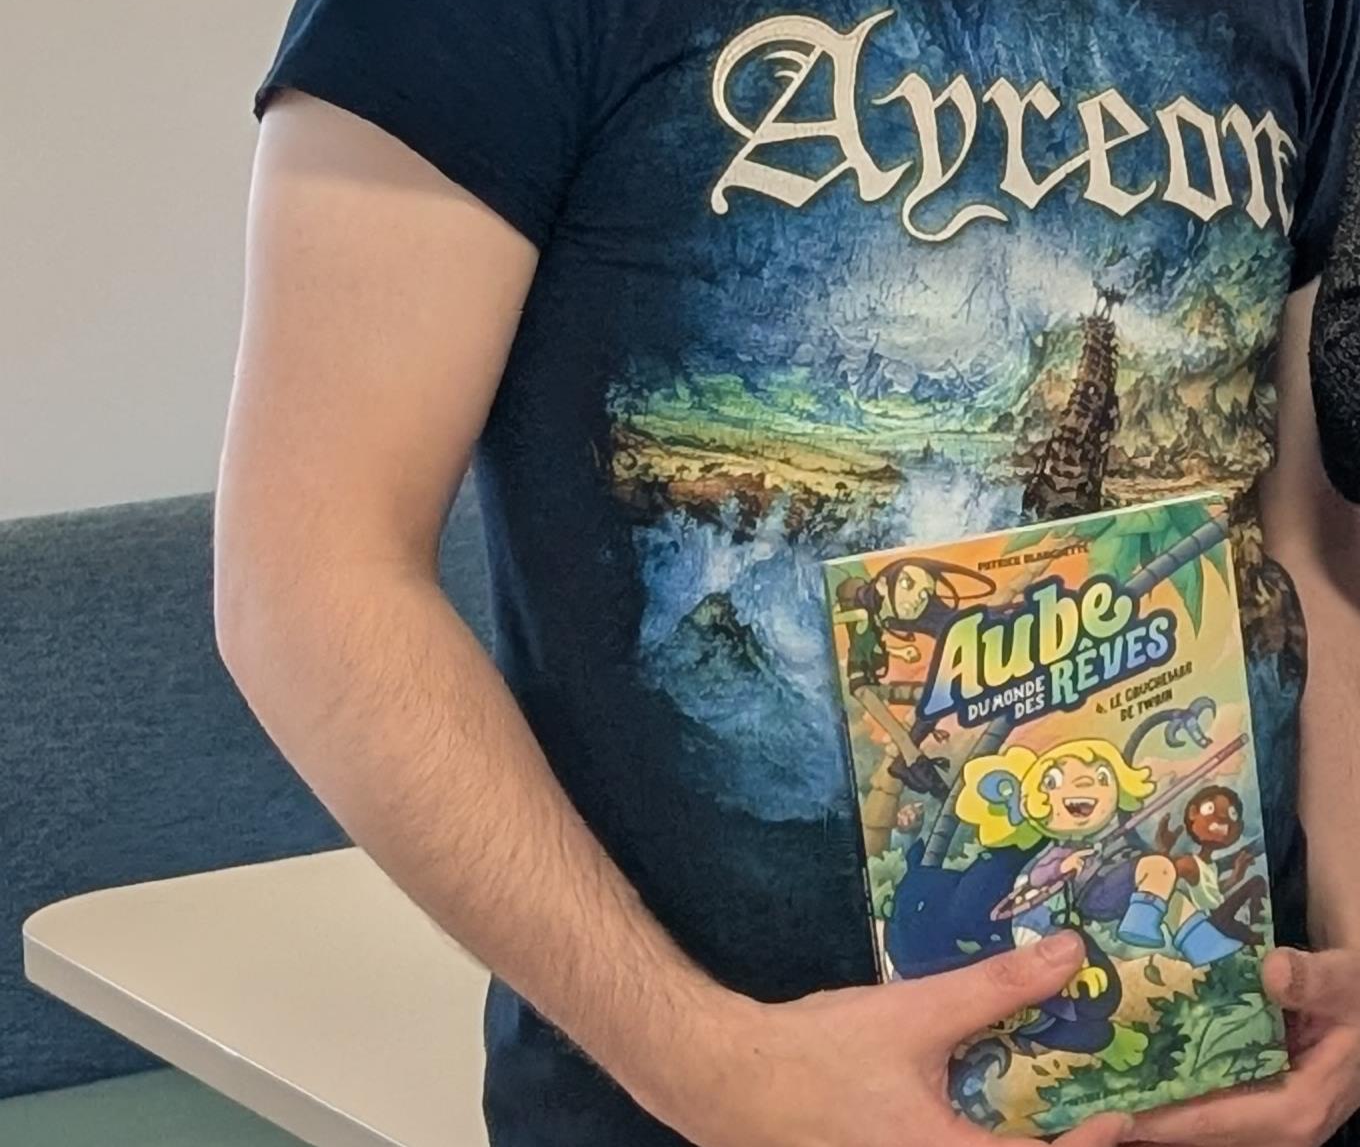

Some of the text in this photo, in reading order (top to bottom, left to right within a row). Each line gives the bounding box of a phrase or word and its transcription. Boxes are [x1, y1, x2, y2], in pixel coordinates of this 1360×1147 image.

[711, 9, 1297, 242] Ayreon
[924, 582, 1134, 715] Aube
[1050, 616, 1171, 707] RÊVES
[967, 675, 1046, 721] DU MONDE
[1014, 693, 1045, 720] DES
[1110, 693, 1122, 709] LE
